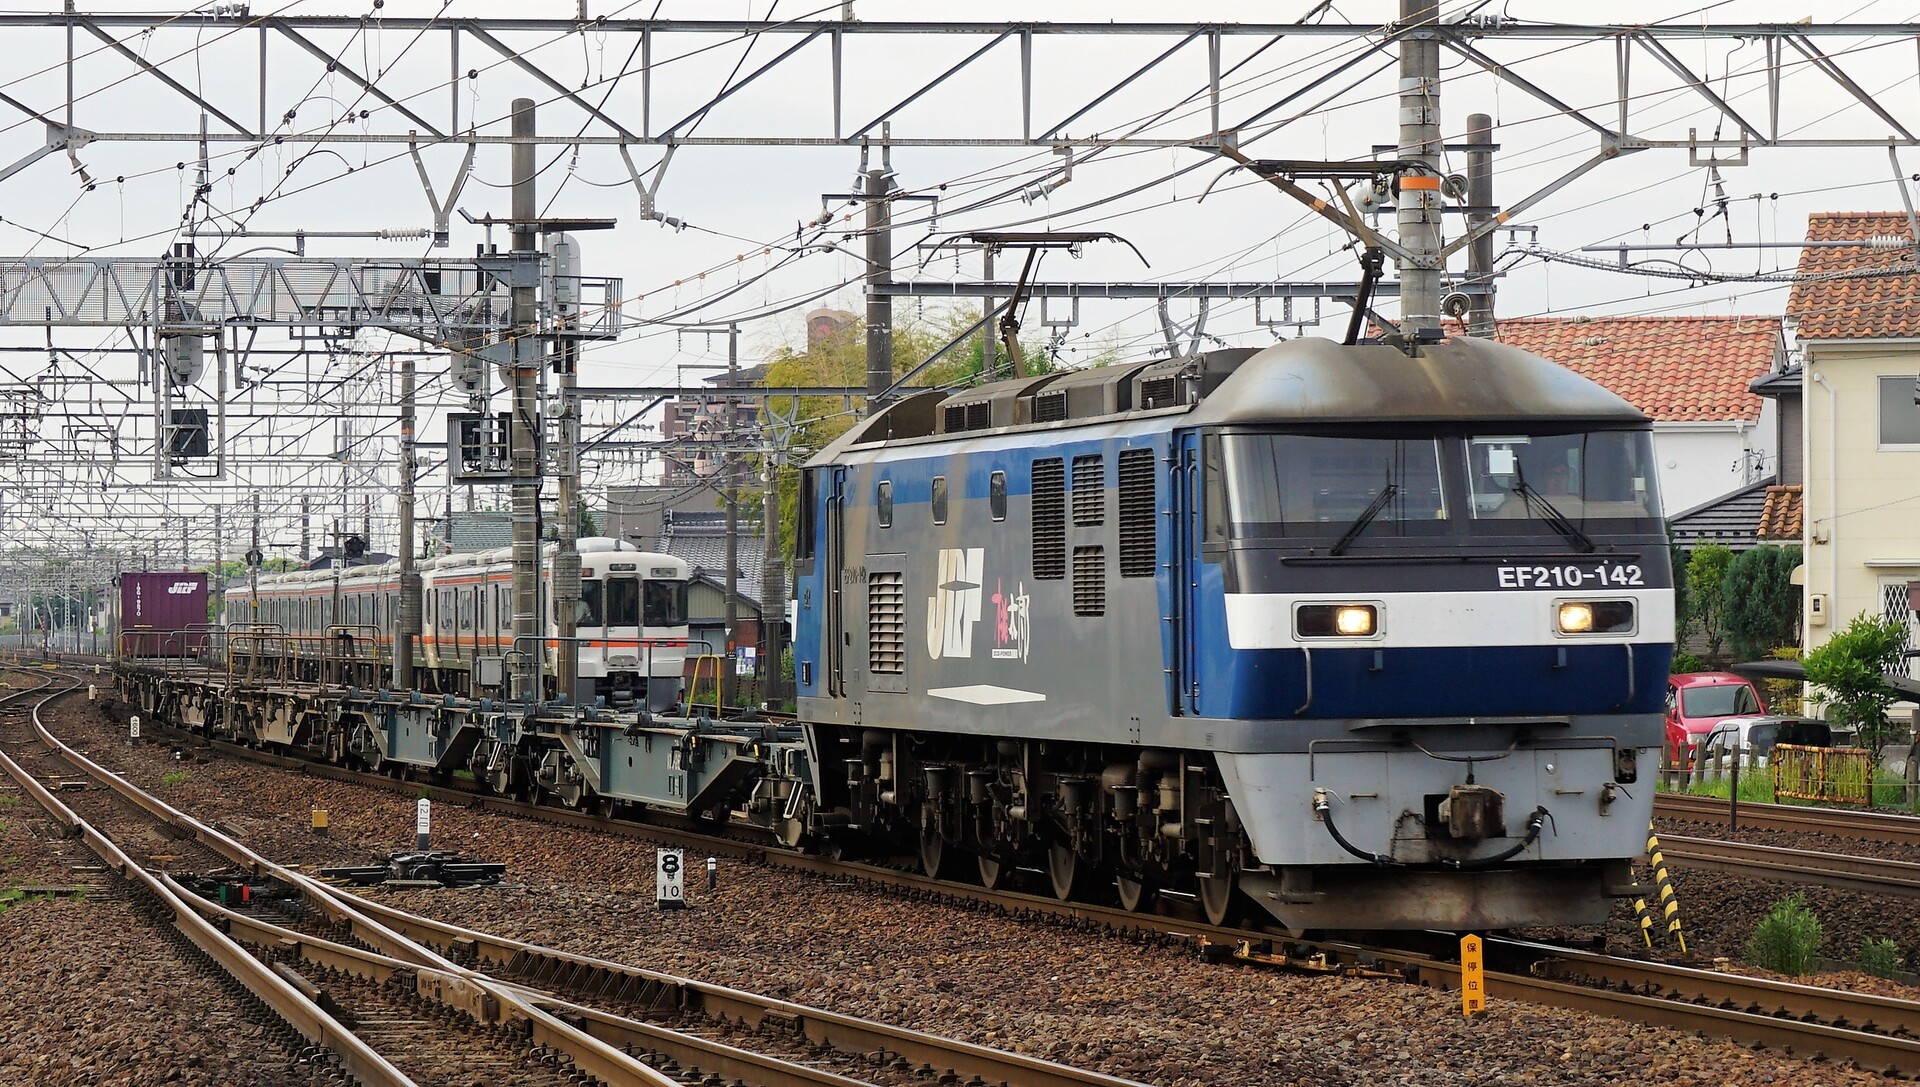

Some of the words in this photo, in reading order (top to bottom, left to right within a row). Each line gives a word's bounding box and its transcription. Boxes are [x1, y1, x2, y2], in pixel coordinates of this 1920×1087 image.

[1497, 565, 1645, 588] EF210-142
[168, 582, 198, 594] JRF
[925, 547, 985, 660] JRF
[419, 803, 429, 828] 1210
[662, 854, 680, 873] 8
[662, 885, 679, 897] 10
